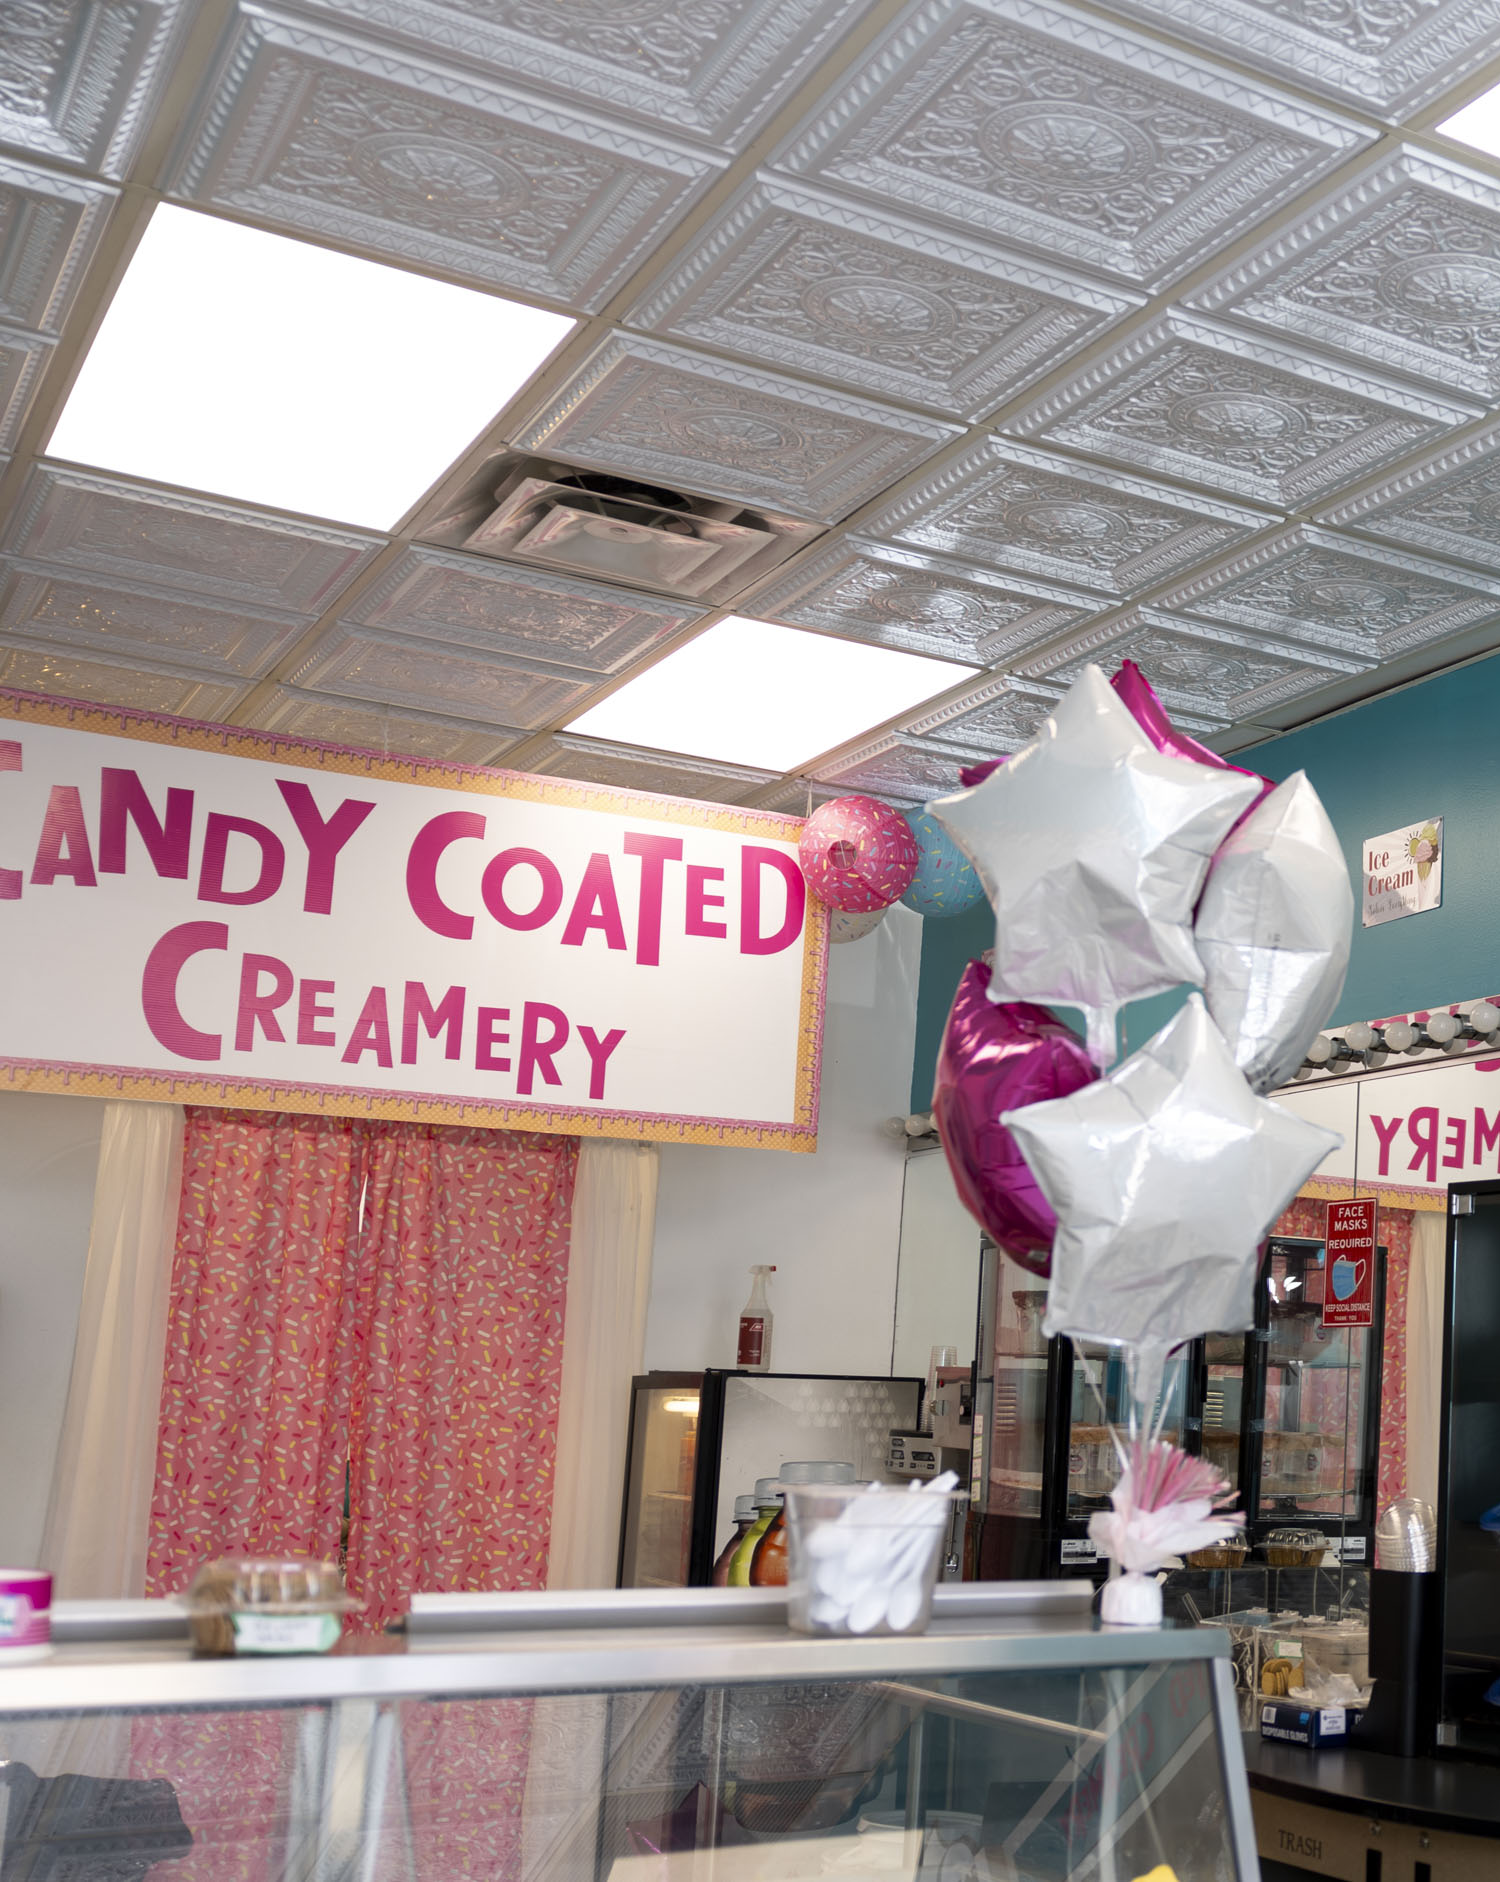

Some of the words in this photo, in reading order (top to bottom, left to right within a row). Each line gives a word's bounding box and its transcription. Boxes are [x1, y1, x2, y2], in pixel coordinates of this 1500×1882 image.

[0, 741, 376, 915] ANDY
[406, 811, 806, 966] COATED
[1369, 851, 1390, 872] Ice
[1368, 869, 1414, 897] Cream
[142, 920, 626, 1100] CREAMERY
[1338, 1206, 1364, 1218] FACE
[1334, 1219, 1368, 1232] MASKS
[1328, 1237, 1372, 1250] REQUIRED
[1325, 1303, 1336, 1313] KEEP
[1336, 1303, 1350, 1312] SOCIAL
[1350, 1302, 1371, 1312] DISTANCE
[1278, 1829, 1322, 1860] TRASH
